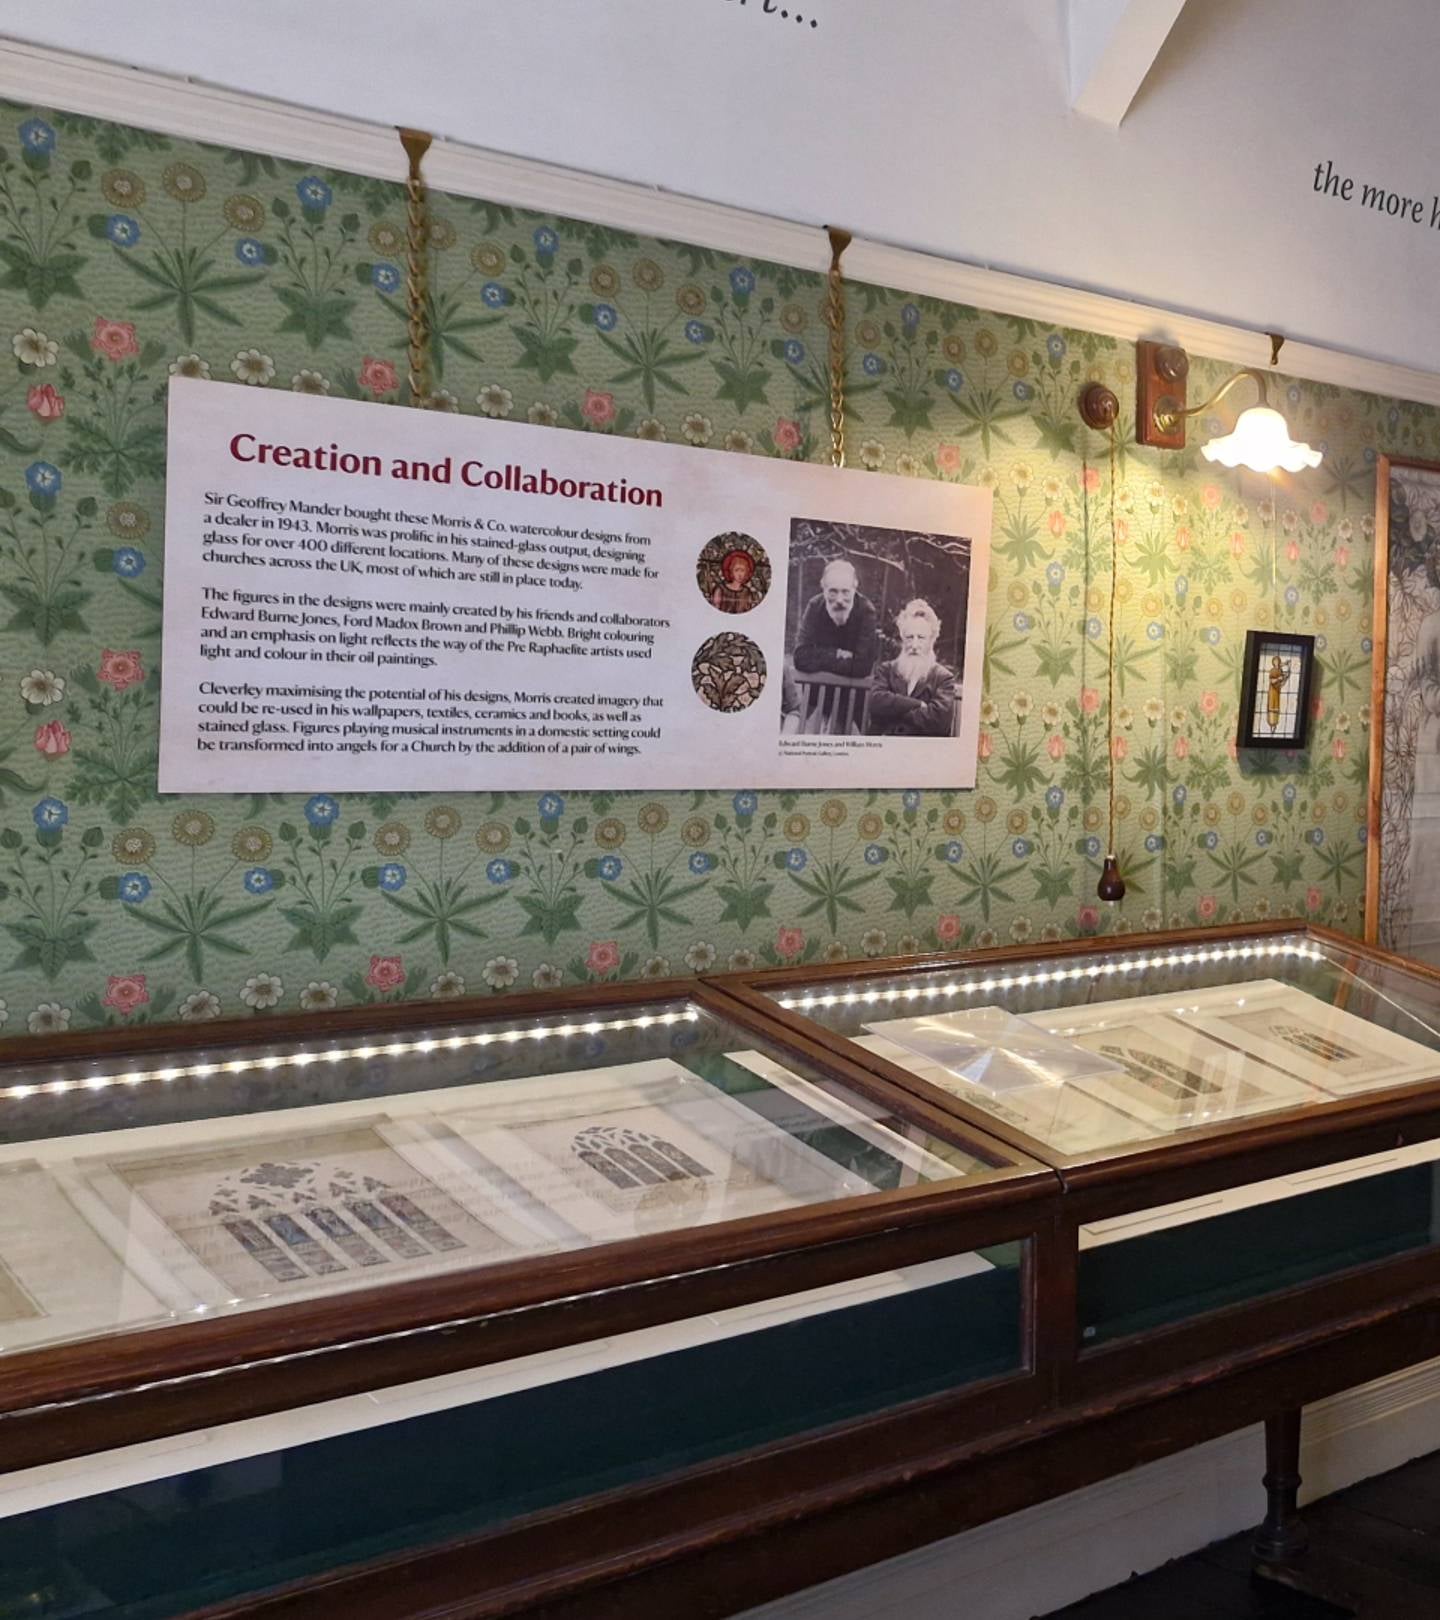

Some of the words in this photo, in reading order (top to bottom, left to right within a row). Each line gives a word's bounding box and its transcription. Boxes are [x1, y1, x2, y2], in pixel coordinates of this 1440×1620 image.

[1313, 161, 1354, 200] the
[1361, 183, 1424, 223] more
[230, 433, 381, 476] Creation
[391, 457, 451, 484] and
[461, 461, 663, 507] Collaboration
[204, 492, 225, 505] Sir
[226, 494, 287, 515] Geoffrey
[289, 500, 342, 517] Mander
[344, 504, 392, 523] bought
[394, 510, 429, 525] these
[432, 513, 472, 529] Morris
[474, 518, 485, 530] &
[487, 519, 507, 532] Co.
[509, 524, 578, 539] watercolour
[580, 528, 623, 545] designs
[625, 532, 651, 546] from
[214, 512, 259, 528] dealer
[278, 518, 312, 533] 1943.
[316, 521, 359, 537] Morris
[361, 528, 388, 539] was
[390, 529, 434, 543] prolific
[451, 532, 468, 546] his
[470, 536, 547, 554] stained-glass
[549, 545, 591, 558] output,
[592, 546, 646, 565] designing
[202, 530, 239, 547] glass
[242, 533, 263, 547] for
[265, 539, 296, 549] over
[298, 538, 328, 552] 400
[330, 540, 386, 557] different
[389, 545, 449, 562] locations.
[452, 550, 485, 568] Many
[502, 555, 537, 569] these
[536, 558, 580, 574] designs
[581, 564, 608, 575] were
[610, 565, 641, 577] made
[644, 567, 660, 579] for
[202, 549, 266, 566] churches
[269, 557, 312, 569] across
[315, 558, 338, 571] the
[366, 564, 400, 576] most
[418, 566, 455, 580] which
[457, 572, 477, 582] are
[480, 571, 500, 583] still
[516, 573, 547, 588] place
[549, 576, 582, 592] today.
[201, 587, 229, 601] The
[233, 589, 280, 606] figures
[298, 593, 320, 606] the
[323, 594, 373, 612] designs
[375, 601, 406, 612] were
[409, 601, 450, 617] mainly
[452, 605, 497, 617] created
[500, 605, 514, 621] by
[516, 607, 533, 619] his
[535, 608, 574, 622] friends
[576, 612, 598, 623] and
[599, 613, 670, 628] collaborators
[201, 606, 255, 621] Edward
[343, 614, 373, 628] Ford
[375, 616, 419, 630] Madox
[421, 618, 462, 632] Brown
[464, 622, 488, 634] and
[567, 627, 601, 642] Bright
[603, 629, 655, 646] colouring
[200, 626, 227, 639] and
[250, 629, 316, 645] emphasis
[318, 634, 336, 644] on
[339, 632, 368, 648] light
[371, 634, 417, 648] reflects
[420, 636, 440, 649] the
[443, 640, 468, 653] way
[485, 639, 504, 652] the
[507, 641, 526, 653] Pre
[529, 641, 588, 657] Raphaelite
[590, 645, 624, 657] artists
[626, 647, 652, 659] used
[200, 643, 232, 661] light
[234, 646, 261, 659] and
[264, 647, 308, 660] colour
[326, 649, 357, 663] their
[358, 651, 374, 664] oil
[377, 653, 438, 669] paintings.
[198, 701, 238, 714] could
[262, 703, 313, 715] re-used
[331, 703, 350, 716] his
[352, 704, 424, 720] wallpapers,
[427, 706, 472, 720] textiles,
[474, 708, 527, 720] ceramics
[529, 708, 551, 720] and
[606, 710, 628, 722] well
[199, 681, 263, 699] Cleverley
[265, 684, 343, 702] maximising
[345, 686, 366, 699] the
[369, 688, 426, 702] potential
[444, 689, 462, 702] his
[514, 691, 551, 704] Morris
[553, 693, 595, 705] created
[597, 694, 640, 709] imagery
[642, 695, 663, 707] that
[198, 720, 249, 733] stained
[251, 720, 290, 736] glass.
[293, 721, 340, 737] Figures
[343, 722, 390, 738] playing
[391, 723, 439, 735] musical
[441, 724, 513, 736] instruments
[537, 725, 590, 738] domestic
[592, 726, 629, 741] setting
[631, 727, 661, 739] could
[219, 738, 305, 751] transformed
[307, 739, 334, 752] into
[336, 739, 378, 755] angels
[381, 740, 400, 752] for
[411, 740, 456, 752] Church
[458, 741, 473, 756] by
[475, 741, 495, 753] the
[497, 741, 545, 753] addition
[571, 743, 592, 757] pair
[608, 743, 642, 757] wings.
